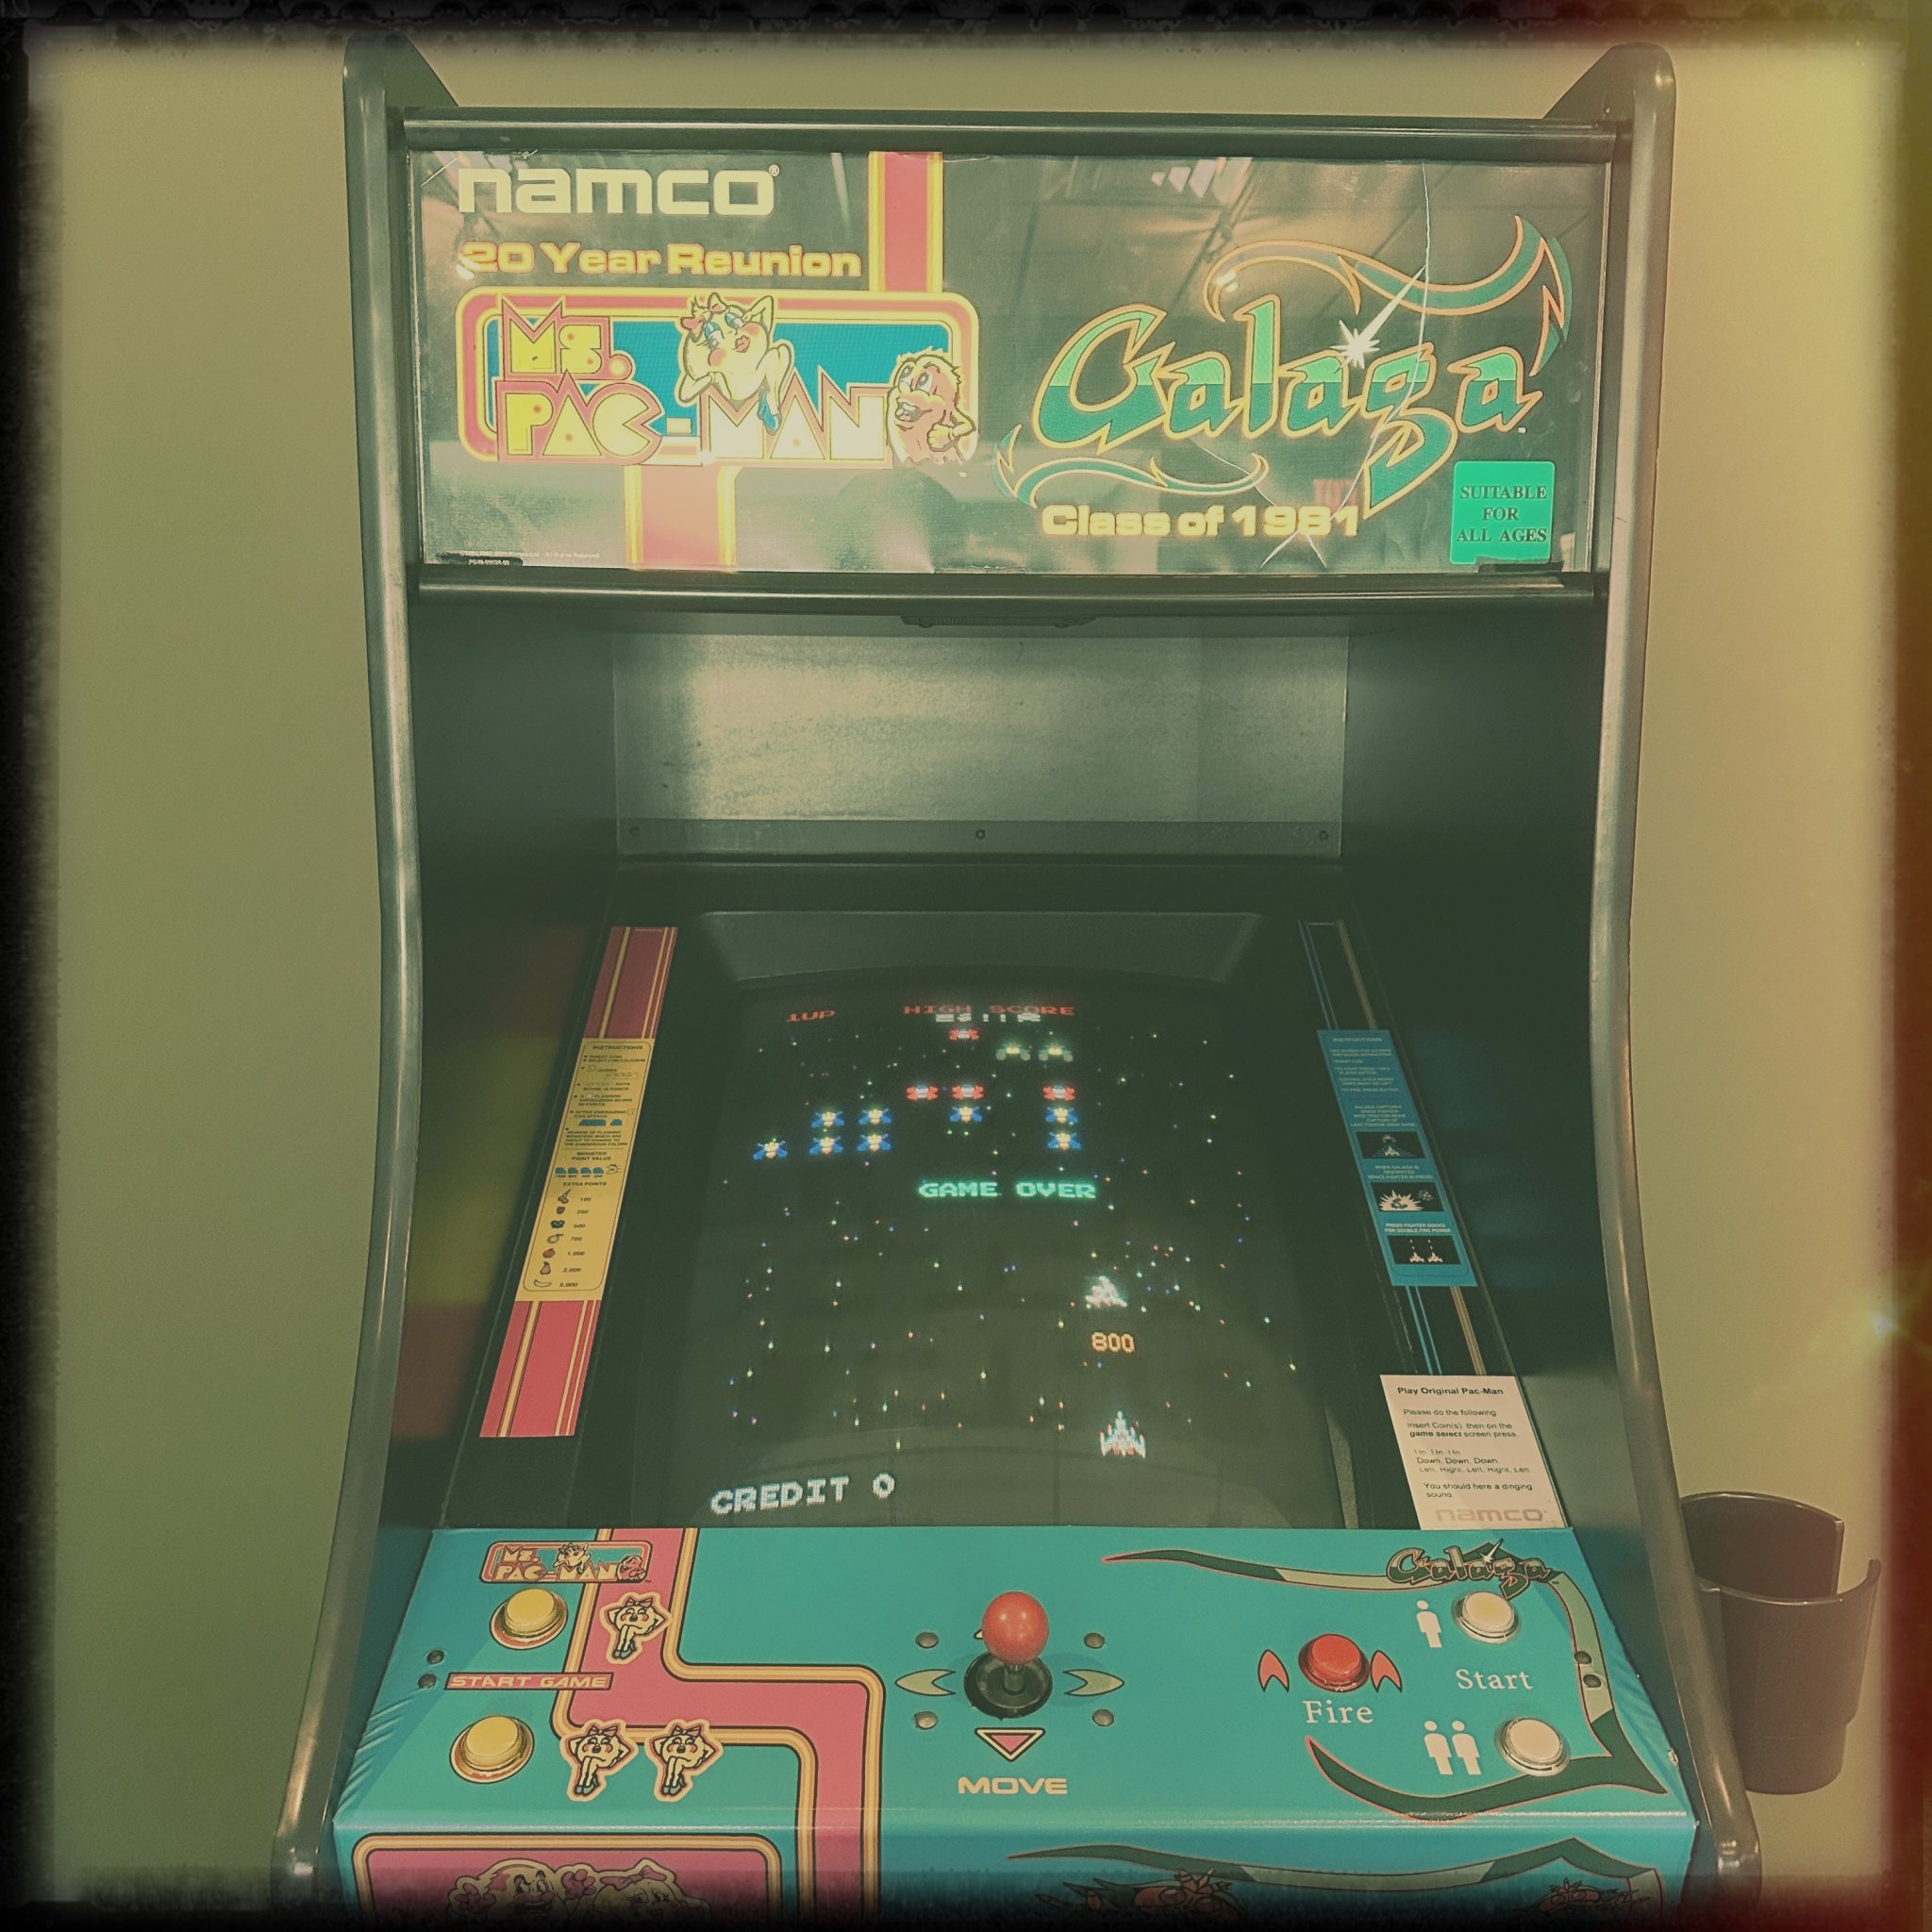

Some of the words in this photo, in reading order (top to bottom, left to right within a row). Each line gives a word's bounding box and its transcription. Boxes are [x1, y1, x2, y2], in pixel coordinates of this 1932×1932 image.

[460, 242, 535, 275] 20
[540, 242, 661, 275] Year
[666, 243, 861, 277] Reunion
[1033, 294, 1542, 519] Galaga
[500, 379, 891, 462] PAC-MAN
[1459, 485, 1548, 500] SUITABLE
[1041, 505, 1172, 537] Class
[1176, 505, 1227, 537] of
[1230, 505, 1360, 538] 1981
[1481, 506, 1520, 521] FOR
[1456, 527, 1493, 542] ALL
[1498, 527, 1548, 542] AGES
[786, 1009, 836, 1023] 1UP
[905, 1005, 973, 1015] HIGH
[990, 1005, 1075, 1016] SCORE
[918, 1181, 998, 1198] GAME
[1015, 1181, 1096, 1199] OVER
[1091, 1331, 1135, 1353] 800
[1397, 1387, 1418, 1395] Play
[1421, 1387, 1459, 1396] Original
[1461, 1387, 1504, 1395] Pac-Man
[709, 1474, 850, 1516] CREDIT
[1387, 1545, 1552, 1600] Galaga
[451, 1674, 531, 1688] START
[540, 1674, 608, 1688] GAME
[1455, 1668, 1533, 1690] Start
[1302, 1699, 1374, 1724] Fire
[958, 1776, 1068, 1795] MOVE
